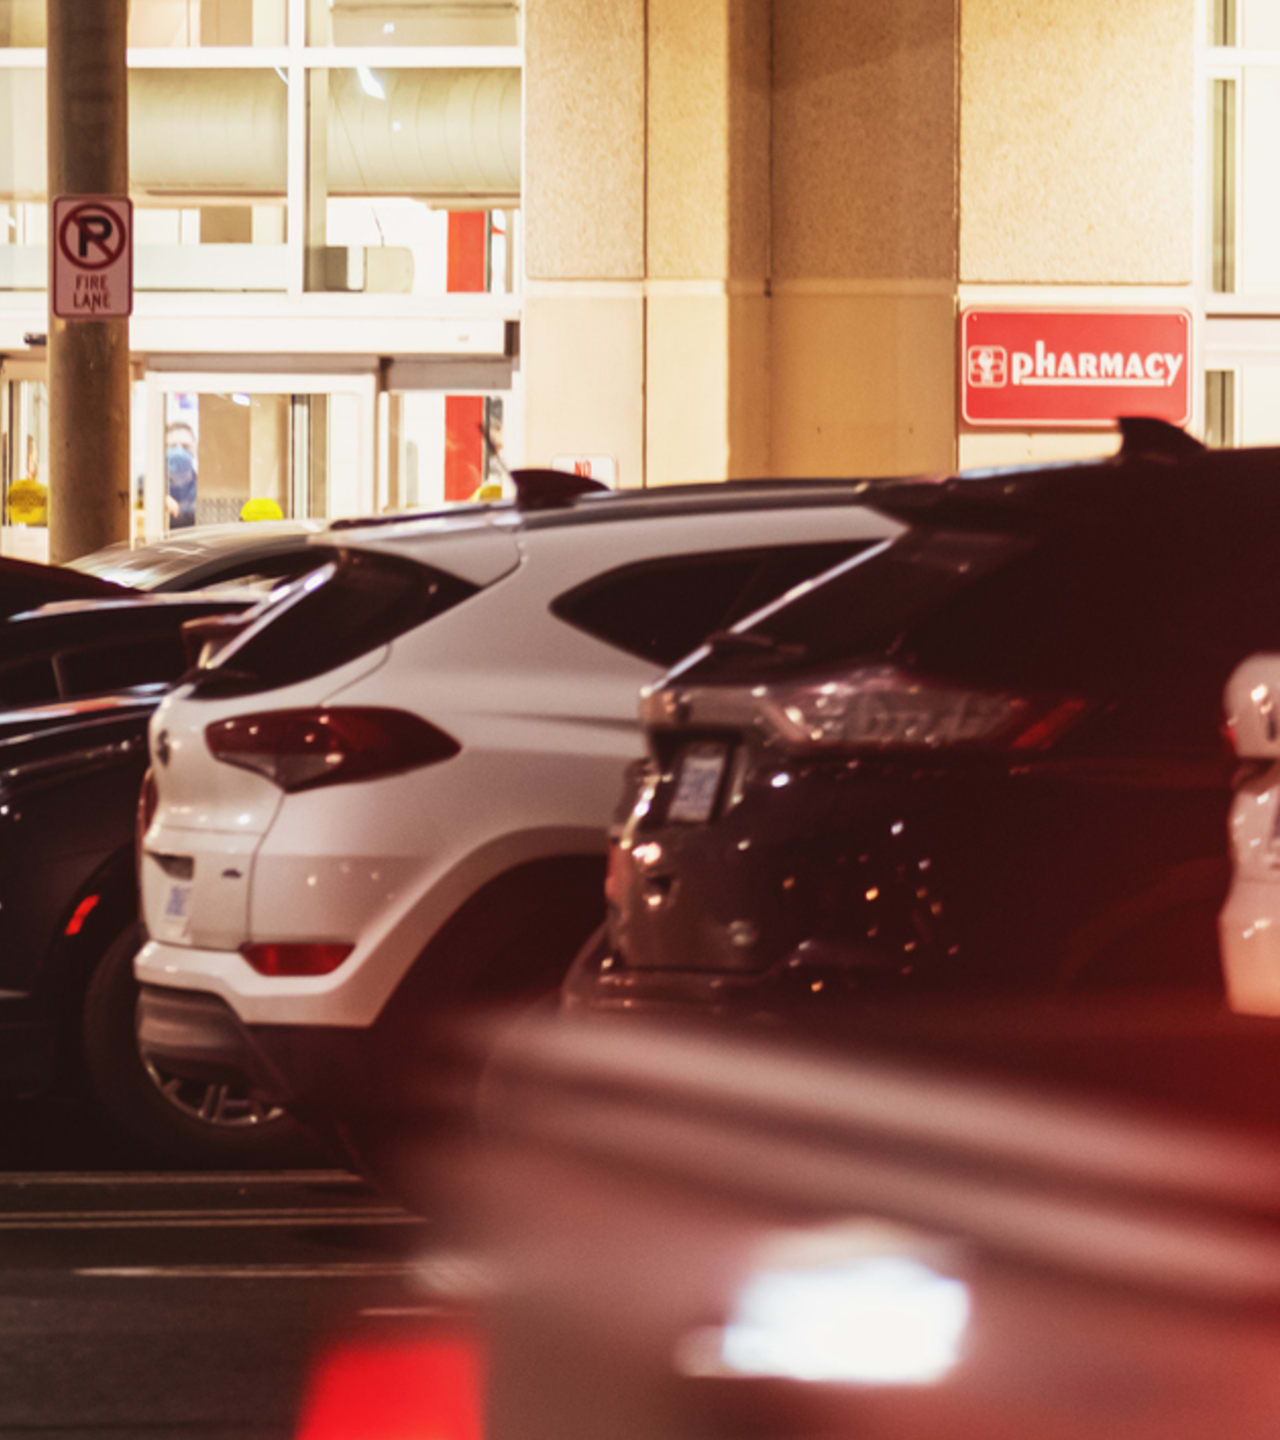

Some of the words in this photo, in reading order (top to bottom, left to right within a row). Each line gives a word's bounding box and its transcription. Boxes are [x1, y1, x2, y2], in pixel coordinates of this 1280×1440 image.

[76, 275, 107, 290] FIRE
[73, 293, 111, 309] LANE
[574, 460, 592, 479] NO
